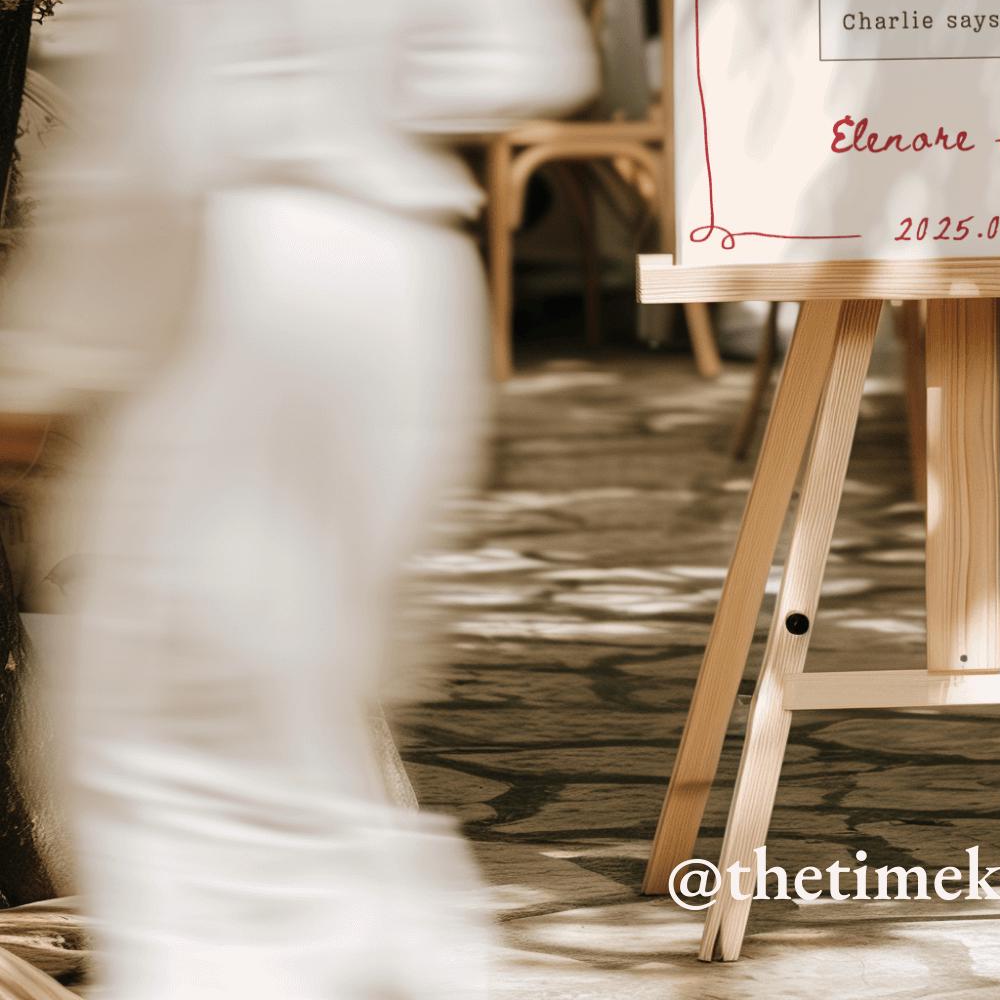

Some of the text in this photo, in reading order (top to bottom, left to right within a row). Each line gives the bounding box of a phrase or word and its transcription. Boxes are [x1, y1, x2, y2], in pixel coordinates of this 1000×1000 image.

[842, 10, 934, 31] Charlie
[946, 14, 1000, 33] says
[830, 115, 976, 153] Elenore
